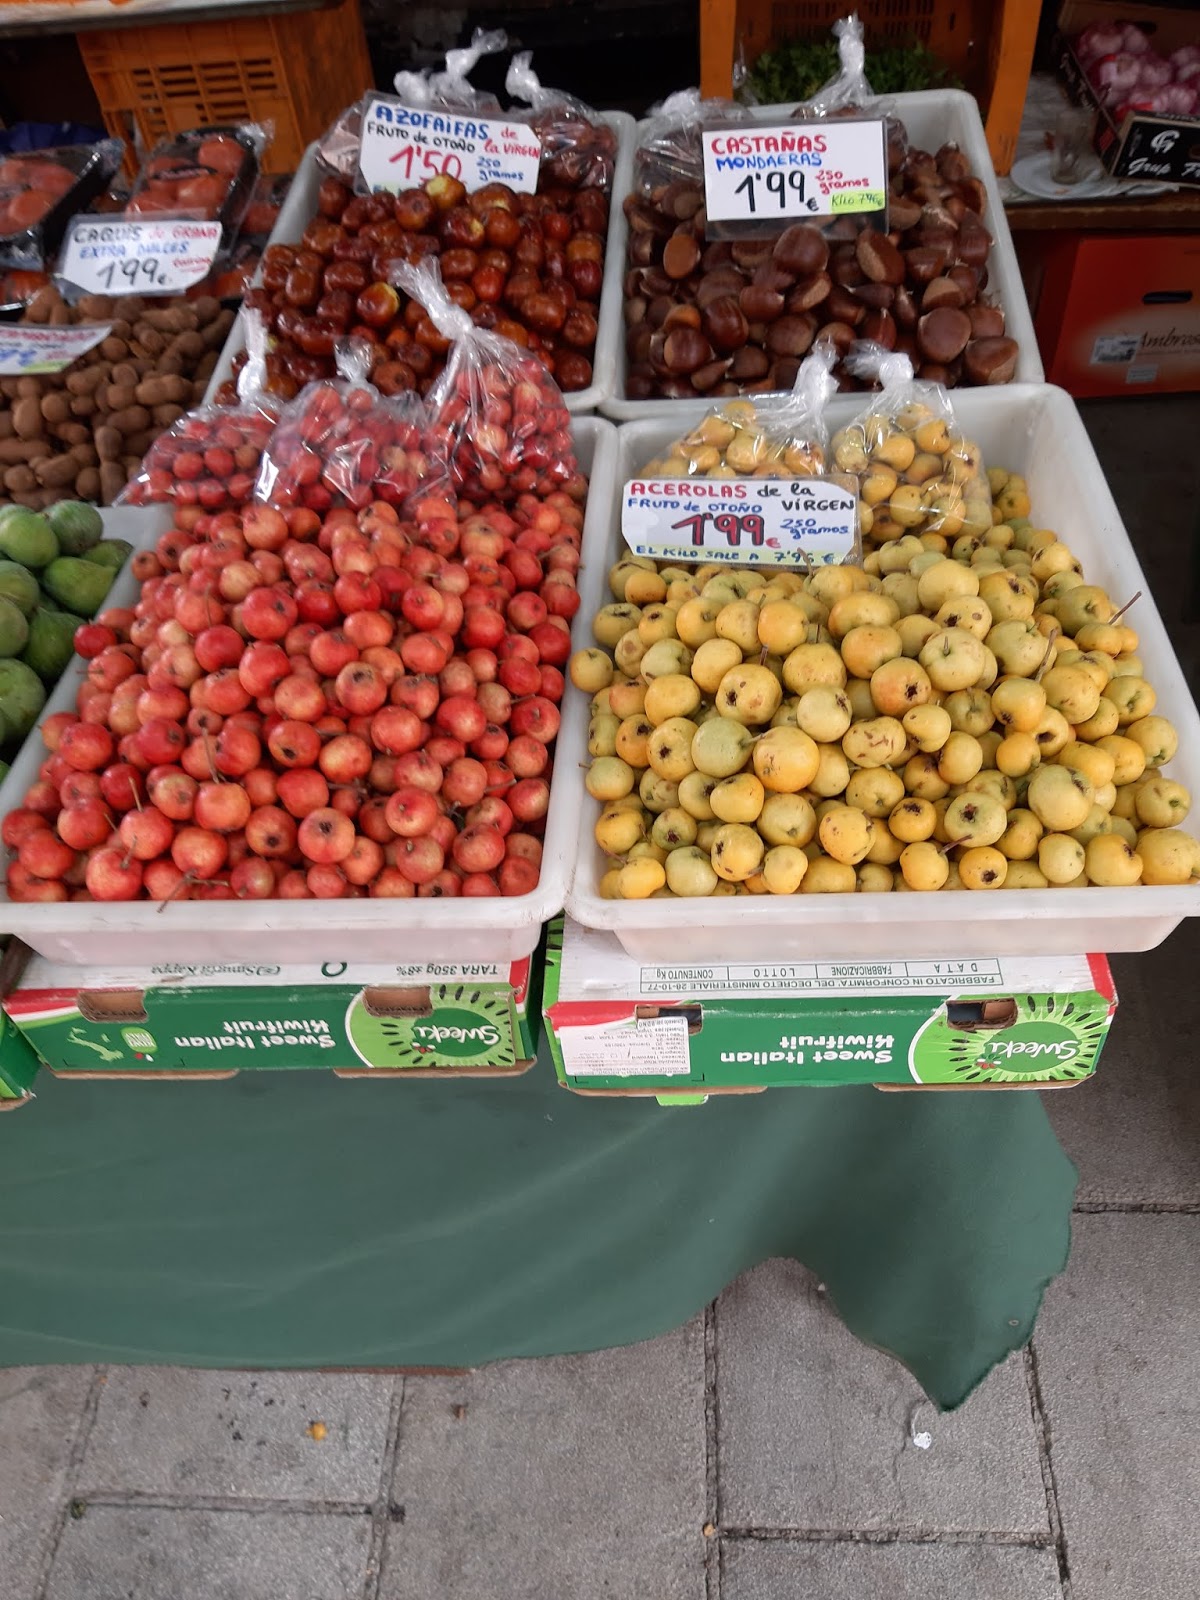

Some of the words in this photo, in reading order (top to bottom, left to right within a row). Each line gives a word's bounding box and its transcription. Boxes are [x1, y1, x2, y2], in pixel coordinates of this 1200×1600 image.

[367, 122, 408, 139] FRUTO
[413, 132, 428, 145] de
[434, 136, 475, 154] OTOÑO
[501, 127, 518, 140] de
[484, 138, 499, 154] la
[711, 131, 827, 155] CASTAÑAS
[476, 156, 501, 168] 250
[716, 153, 822, 172] MONDAERAS
[479, 168, 524, 182] gramos
[815, 170, 843, 181] 250
[819, 177, 869, 196] gramos
[630, 482, 747, 499] ACEROLAS
[757, 483, 781, 498] de
[790, 482, 815, 497] la
[628, 498, 680, 509] FRUTO
[683, 501, 700, 512] de
[708, 502, 763, 514] OTOÑO
[780, 518, 816, 531] 250
[789, 525, 849, 540] gramos
[636, 545, 657, 555] EL
[706, 550, 740, 560] SALE
[749, 551, 760, 561] A
[426, 963, 458, 976] 350g
[463, 963, 498, 976] TARA
[656, 968, 667, 980] Kg
[668, 969, 714, 980] CONTENUTO
[831, 966, 892, 975] FABBRICAZIONE
[648, 983, 687, 991] 28-10-77
[690, 981, 760, 990] MINISTERIALE
[762, 980, 812, 989] DECRETO
[815, 979, 835, 988] DEL
[913, 978, 923, 986] IN
[926, 976, 995, 985] FABBRICATO
[223, 1019, 330, 1034] Kiwifruit
[174, 1034, 256, 1050] Italian
[261, 1033, 337, 1049] Sweet
[779, 1034, 895, 1049] Kiwifruit
[720, 1051, 804, 1066] Italian
[812, 1050, 893, 1064] Sweet
